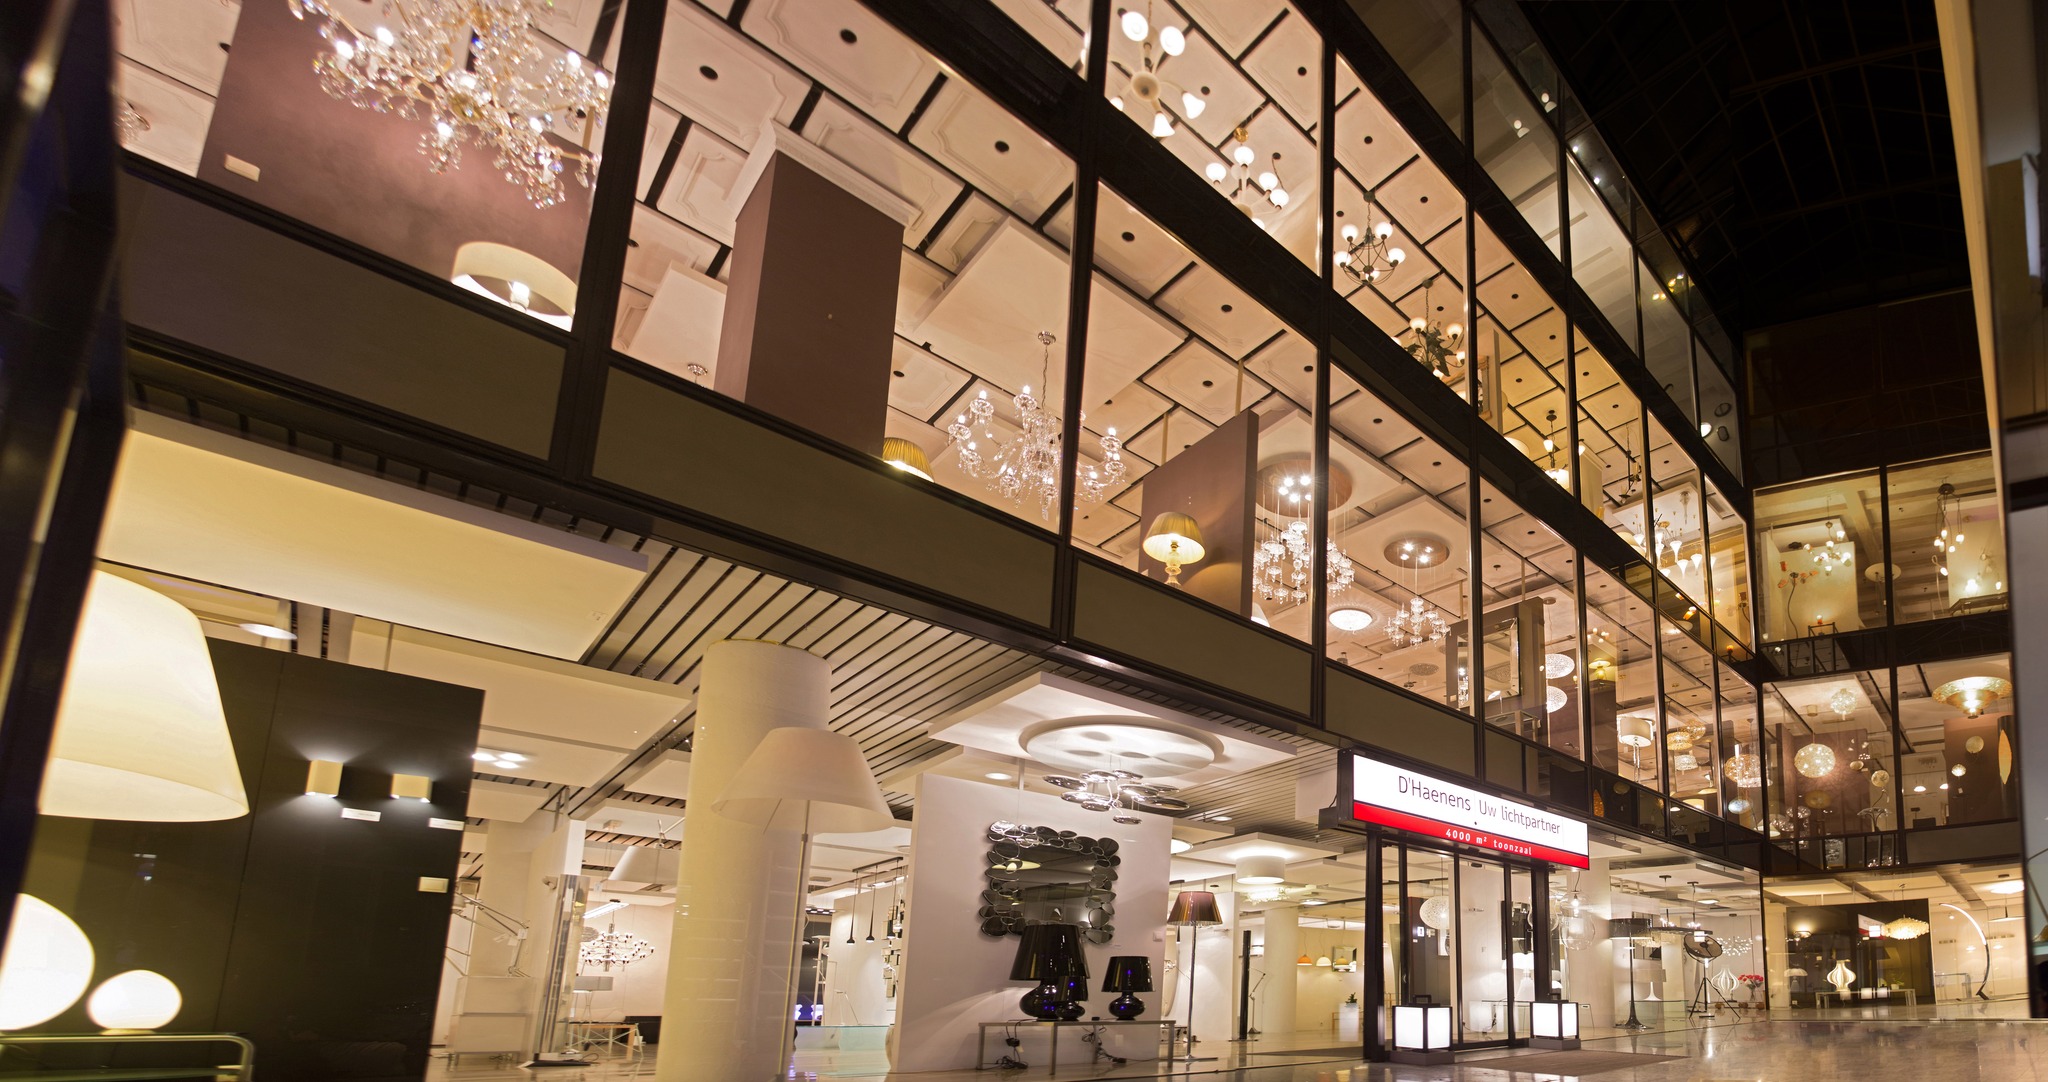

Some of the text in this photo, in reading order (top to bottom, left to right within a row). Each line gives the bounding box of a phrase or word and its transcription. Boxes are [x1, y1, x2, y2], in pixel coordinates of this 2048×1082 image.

[1398, 775, 1561, 834] D'Haenens Uw lichtpartner
[1445, 828, 1471, 842] 4000
[1493, 839, 1532, 855] toonzaal
